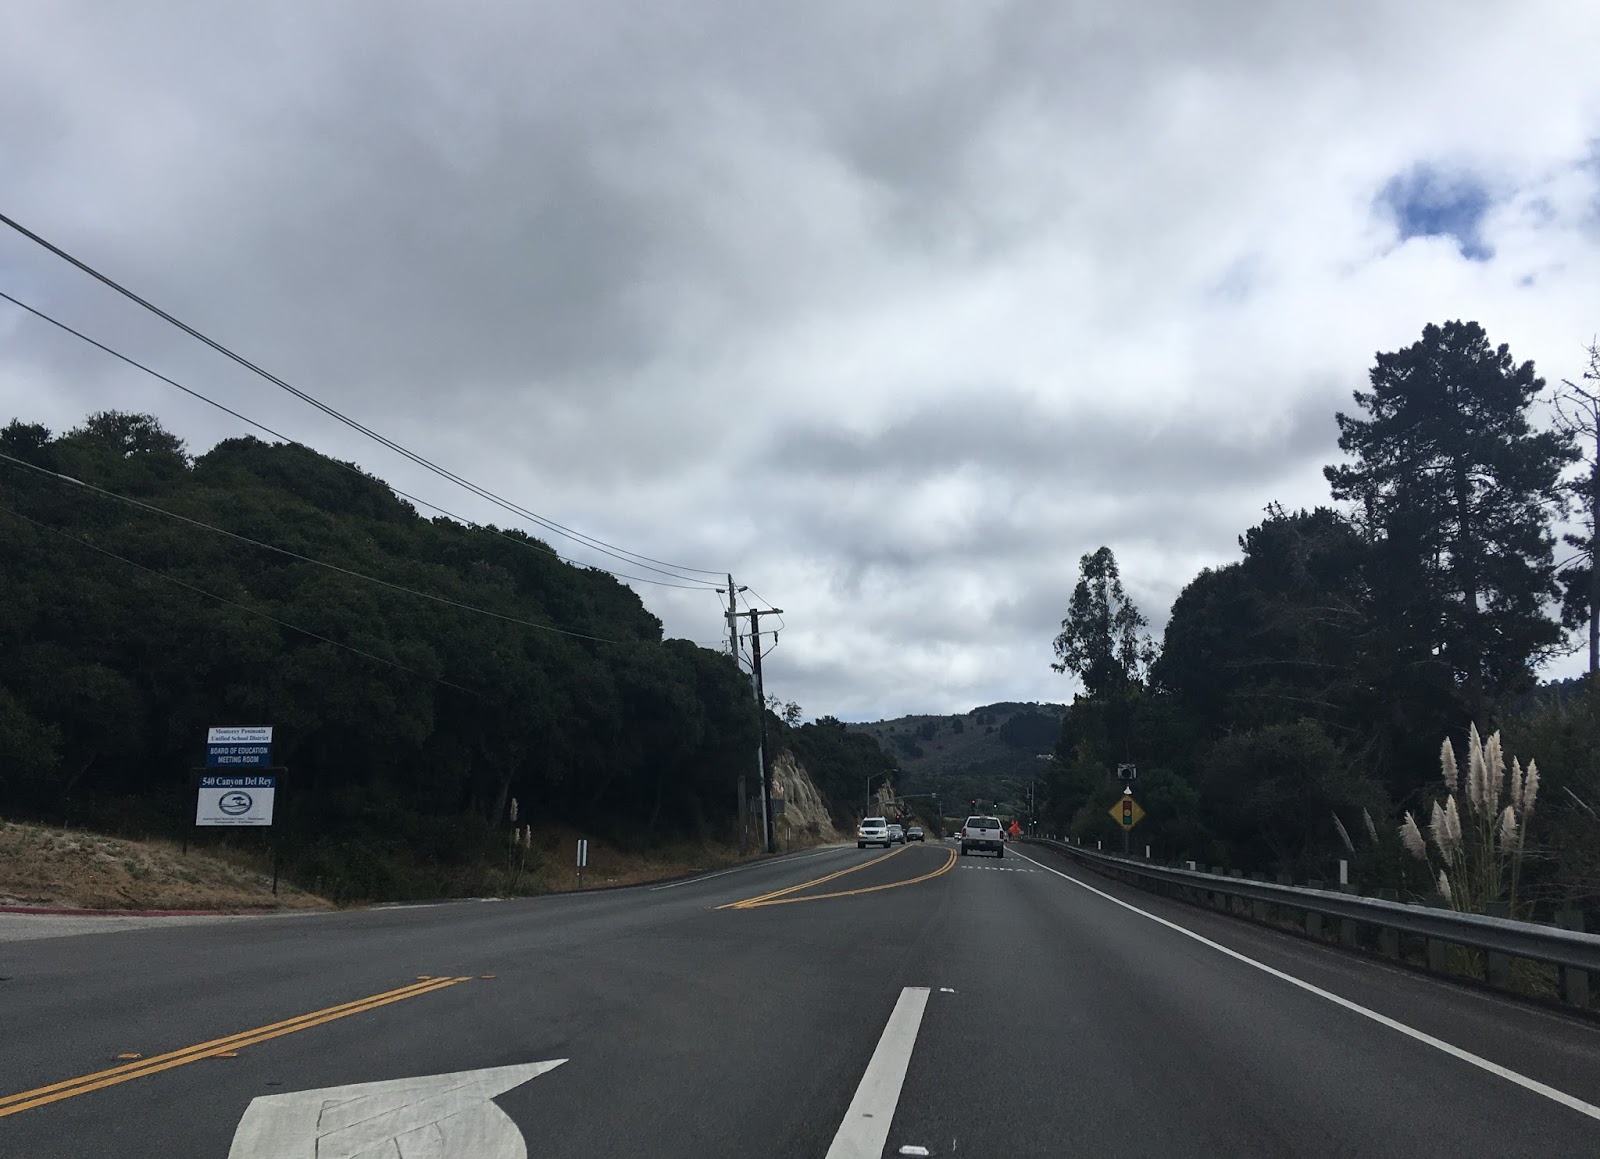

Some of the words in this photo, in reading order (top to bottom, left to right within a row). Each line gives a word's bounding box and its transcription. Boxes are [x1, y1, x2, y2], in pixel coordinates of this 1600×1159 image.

[202, 777, 215, 786] 540
[216, 777, 243, 787] Canyon
[245, 777, 256, 785] Del
[259, 777, 272, 787] Rey
